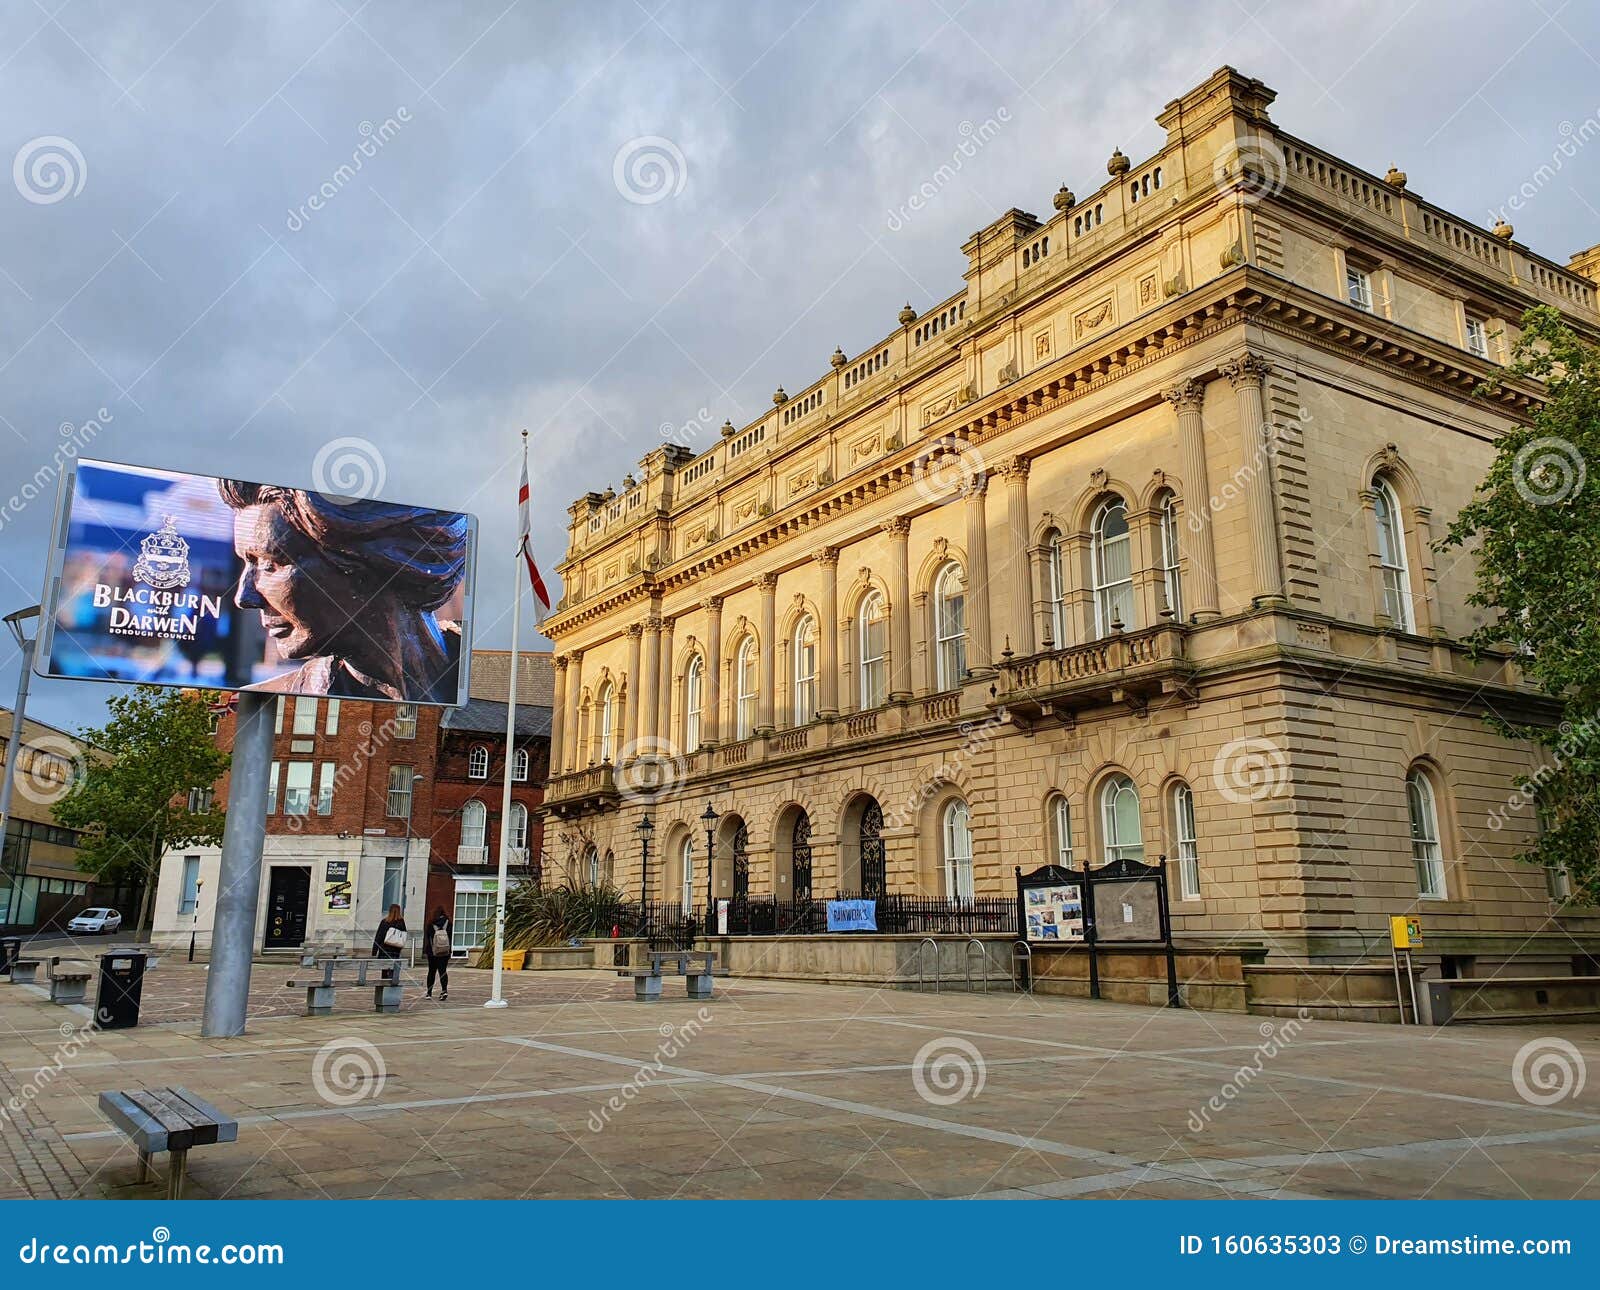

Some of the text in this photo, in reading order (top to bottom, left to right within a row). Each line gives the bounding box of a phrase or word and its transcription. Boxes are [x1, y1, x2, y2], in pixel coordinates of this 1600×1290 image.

[93, 583, 221, 619] BLACKBURN
[146, 605, 170, 615] with
[109, 606, 198, 635] DARWEN
[109, 628, 195, 641] BOROUGH COUNCIL
